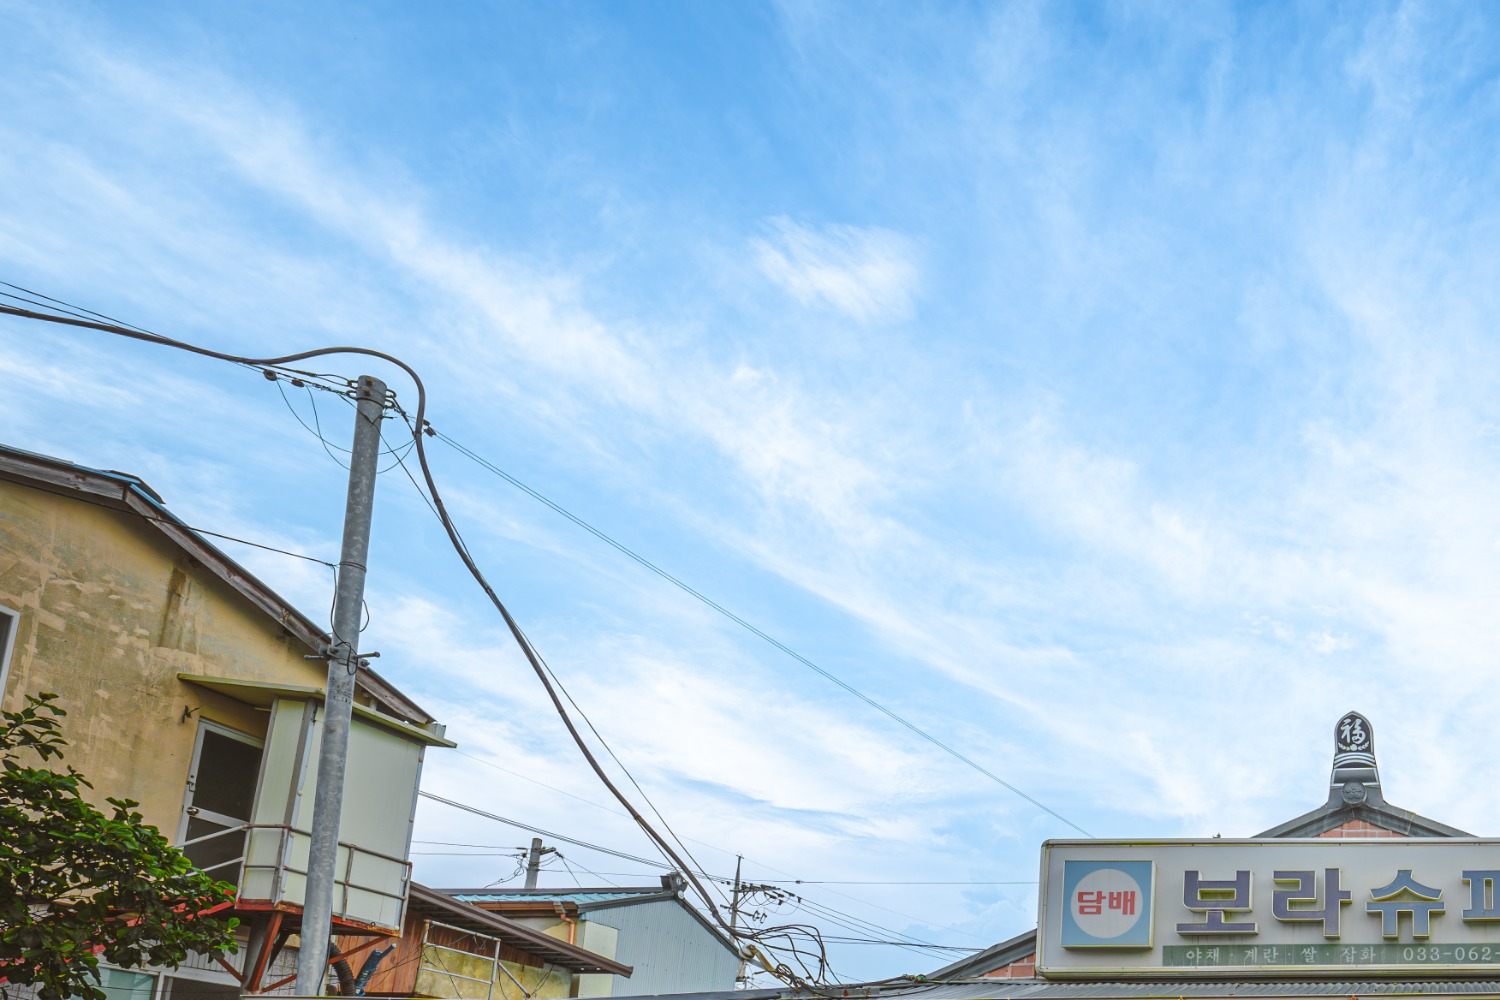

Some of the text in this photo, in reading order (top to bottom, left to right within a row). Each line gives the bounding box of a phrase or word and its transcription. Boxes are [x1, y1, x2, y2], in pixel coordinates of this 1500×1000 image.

[1078, 891, 1135, 915] 담배
[1186, 946, 1220, 964] 야채
[1244, 946, 1279, 964] 계란
[1301, 946, 1317, 963] 쌀
[1341, 946, 1377, 963] 잡화
